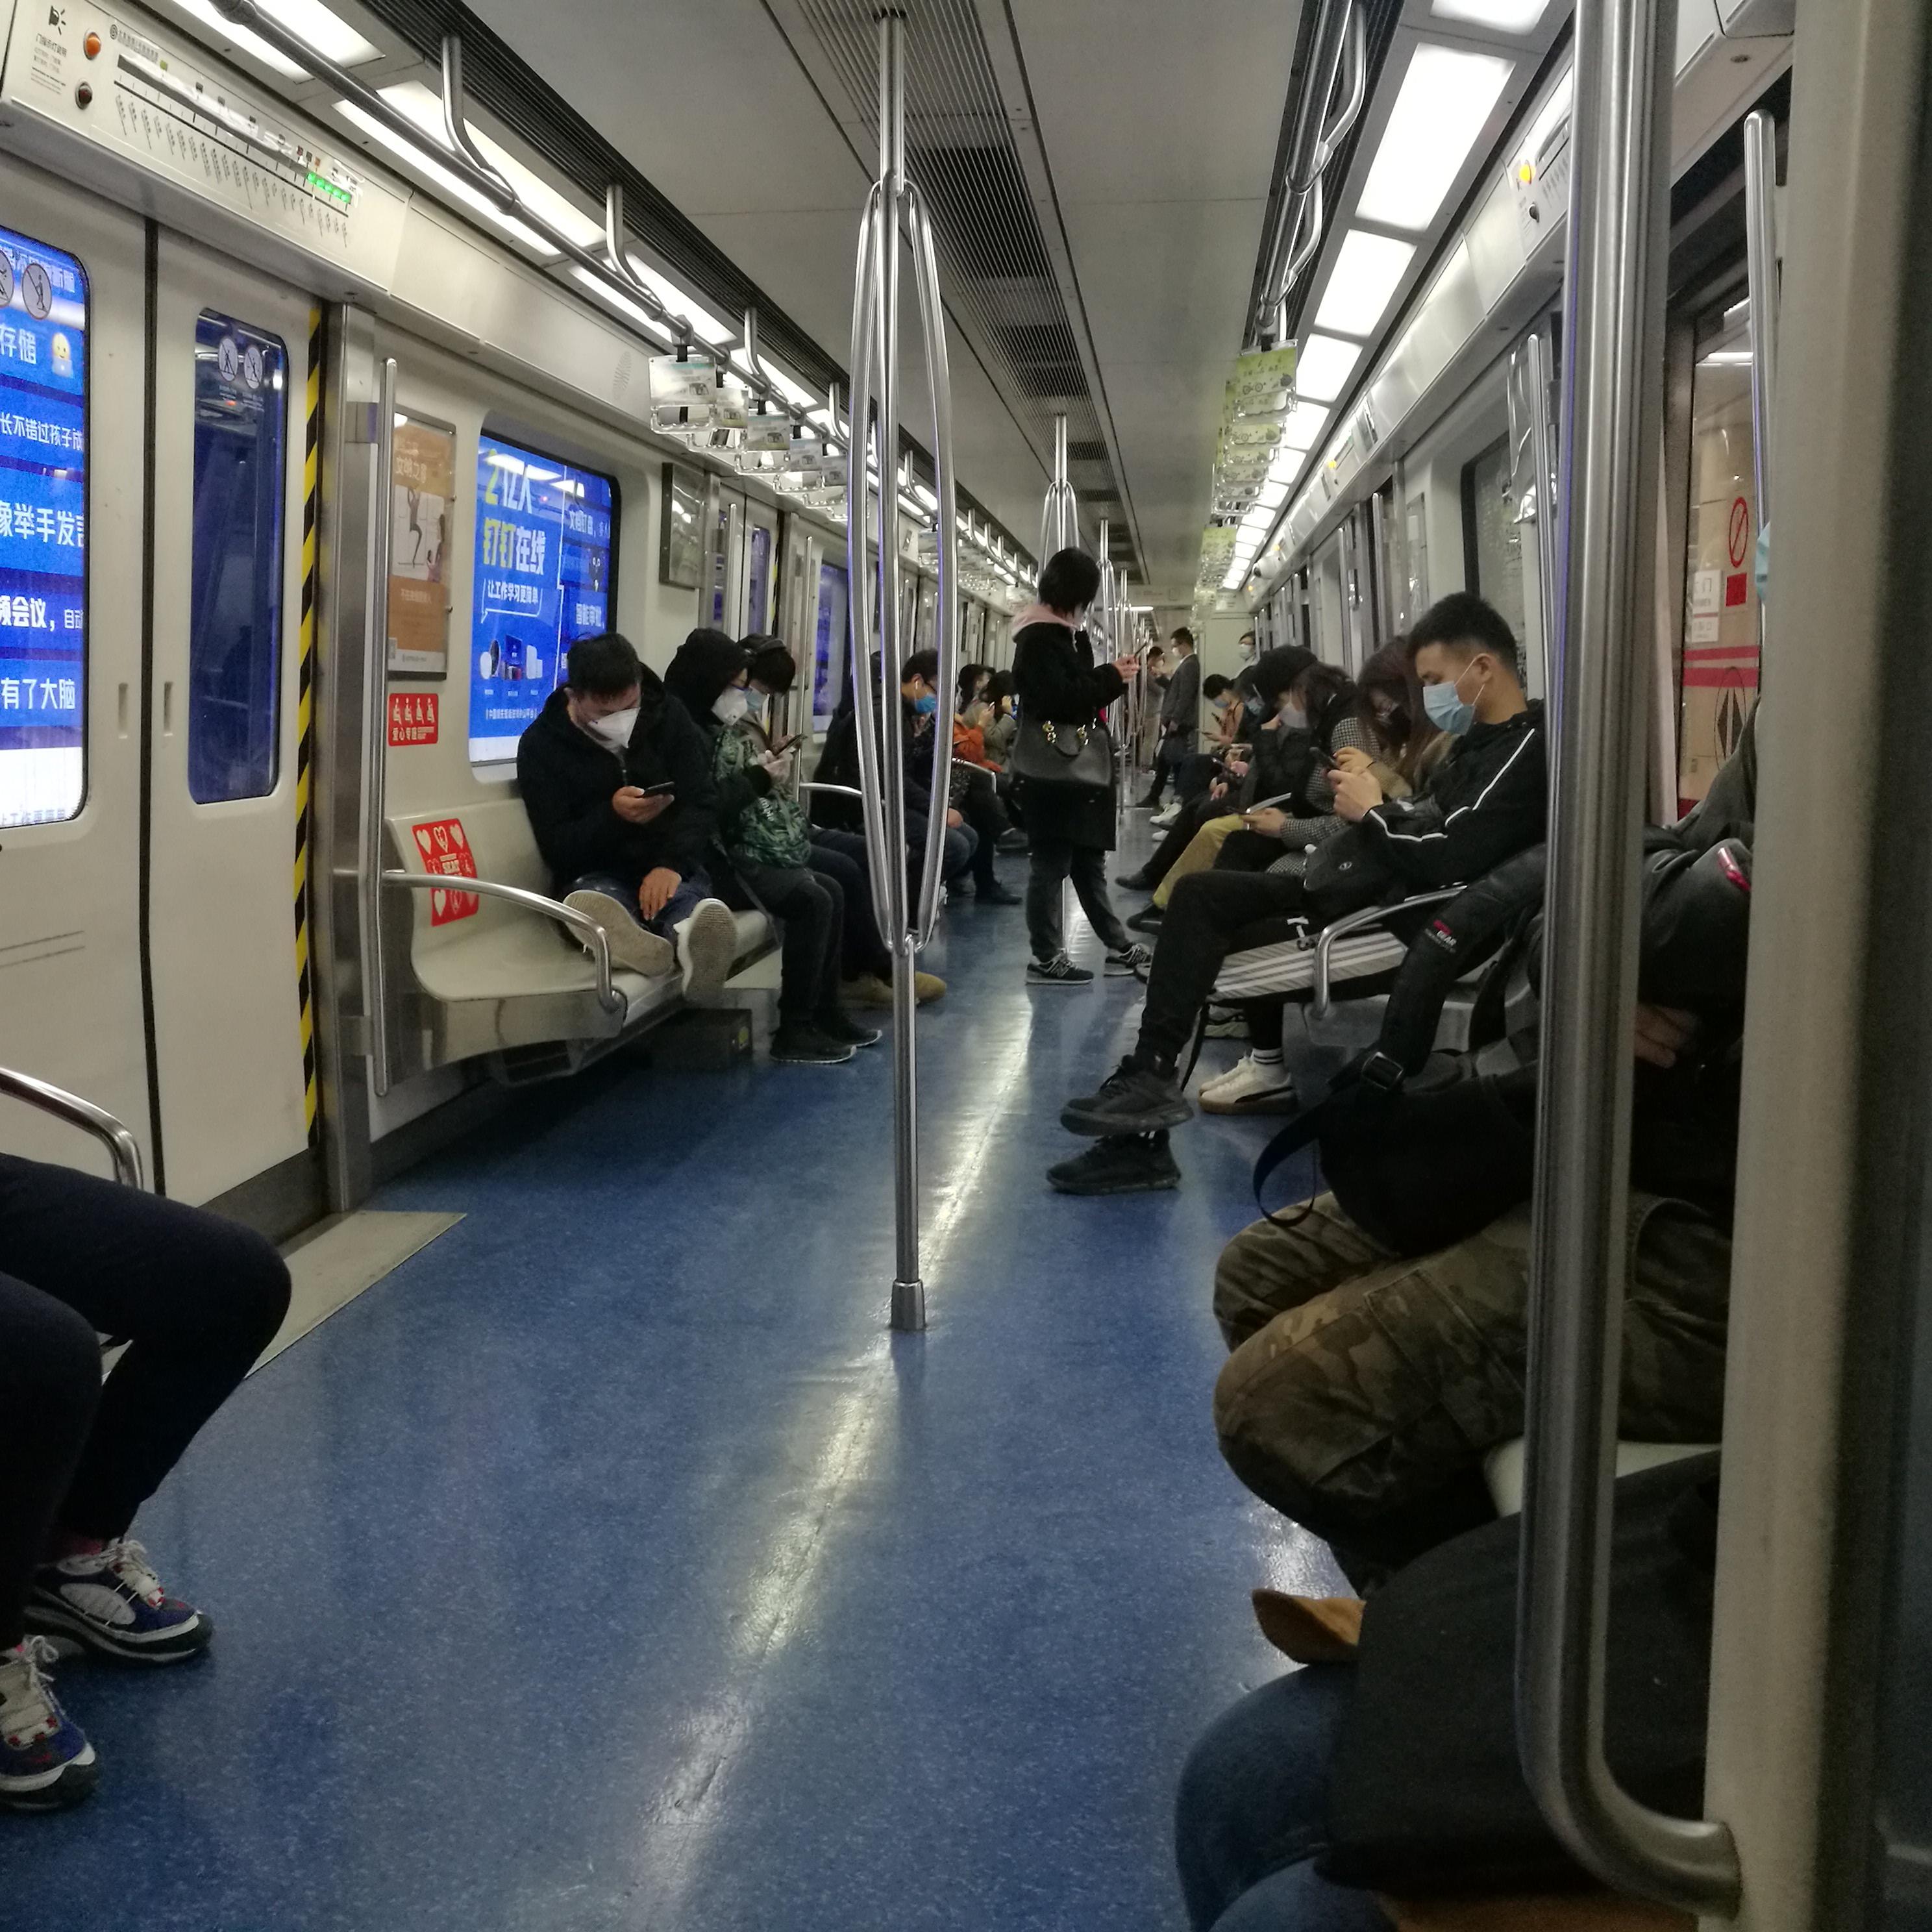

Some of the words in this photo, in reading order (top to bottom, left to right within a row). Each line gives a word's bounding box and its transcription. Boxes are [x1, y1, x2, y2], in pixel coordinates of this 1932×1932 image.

[483, 517, 545, 576] 钉钉在线
[1, 677, 75, 710] 有了大脑
